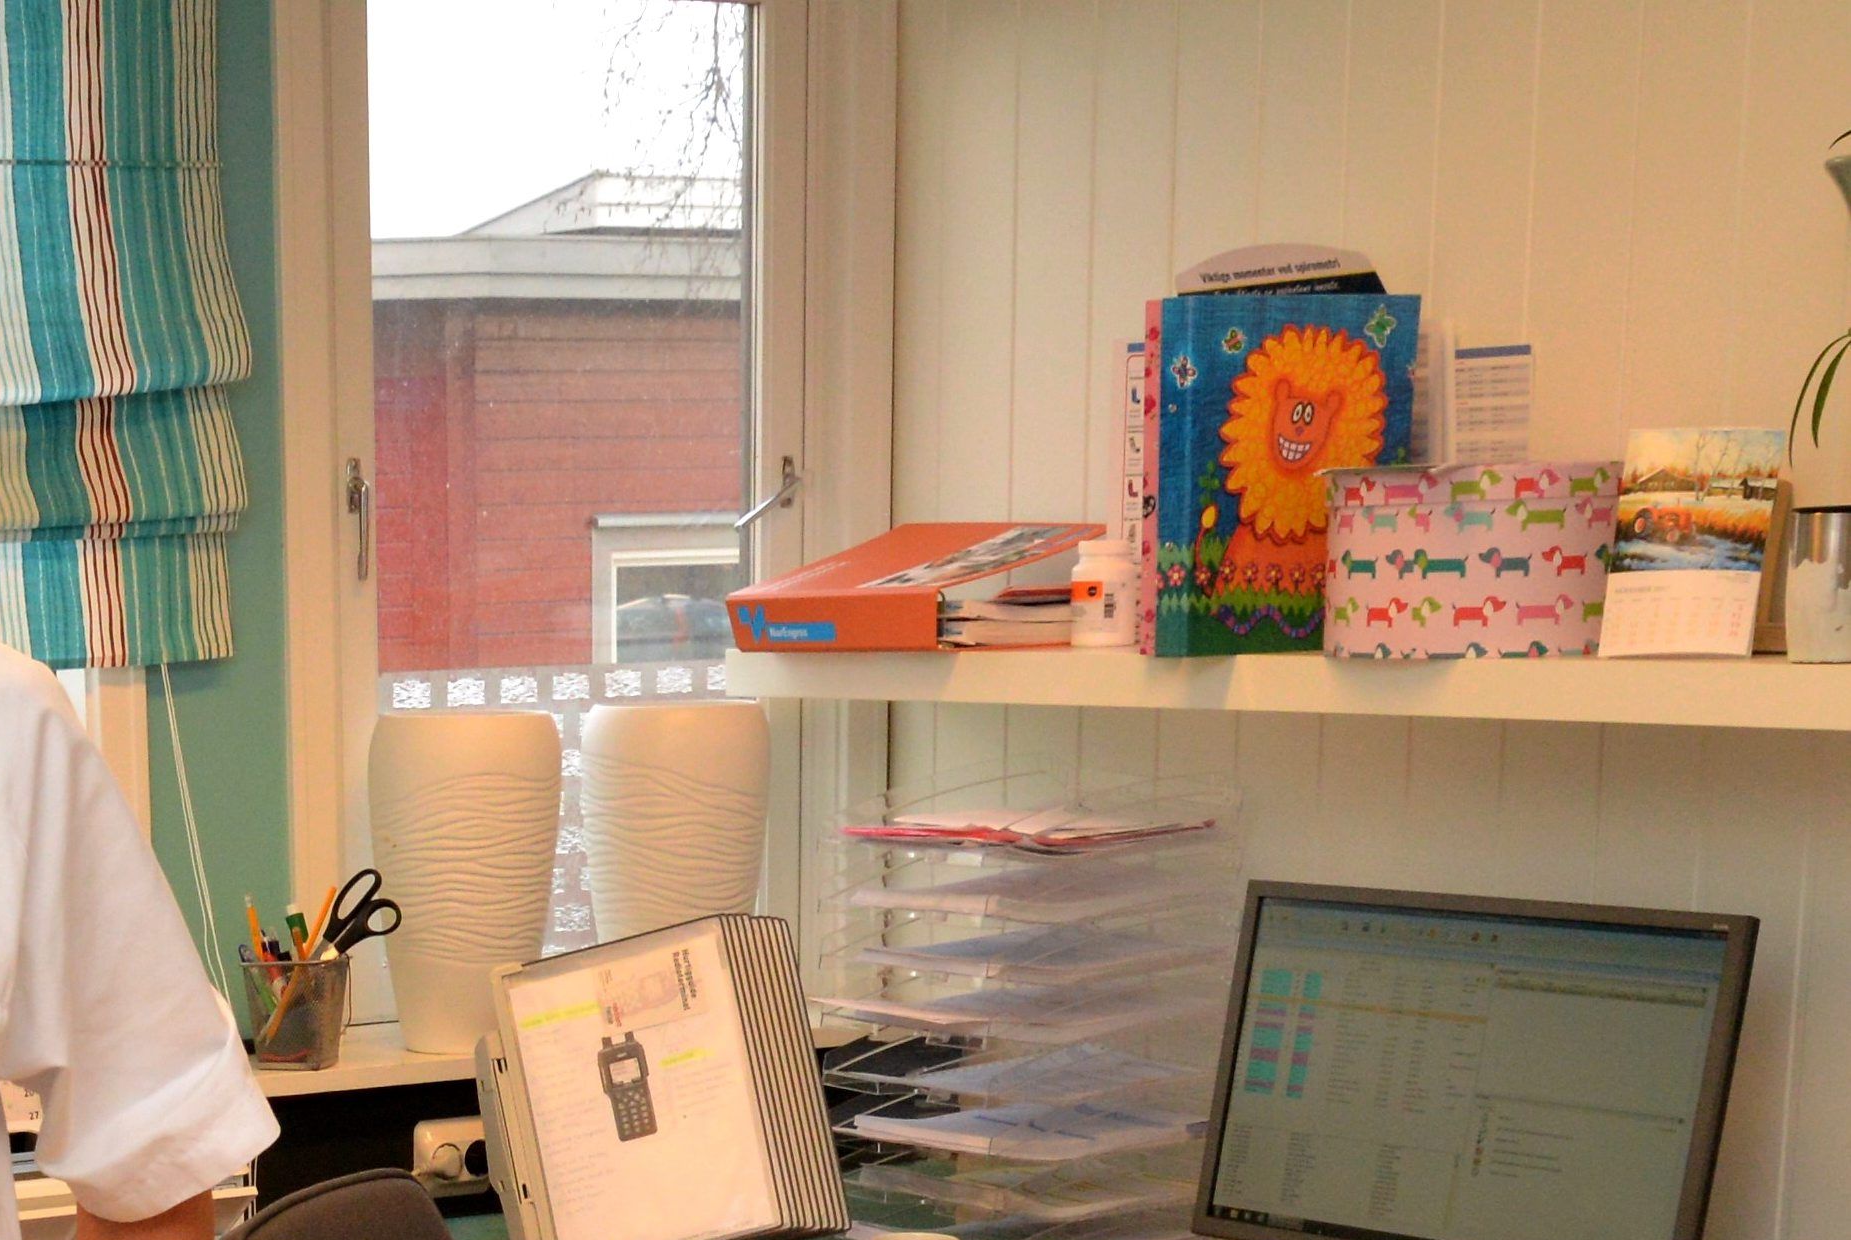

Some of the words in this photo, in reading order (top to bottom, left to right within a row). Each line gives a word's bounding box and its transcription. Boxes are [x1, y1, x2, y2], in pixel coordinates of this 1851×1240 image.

[1201, 271, 1233, 283] Viktige
[1234, 267, 1275, 280] momenter
[1278, 264, 1293, 275] ved
[1294, 258, 1340, 274] spirometri
[29, 1110, 39, 1120] 27
